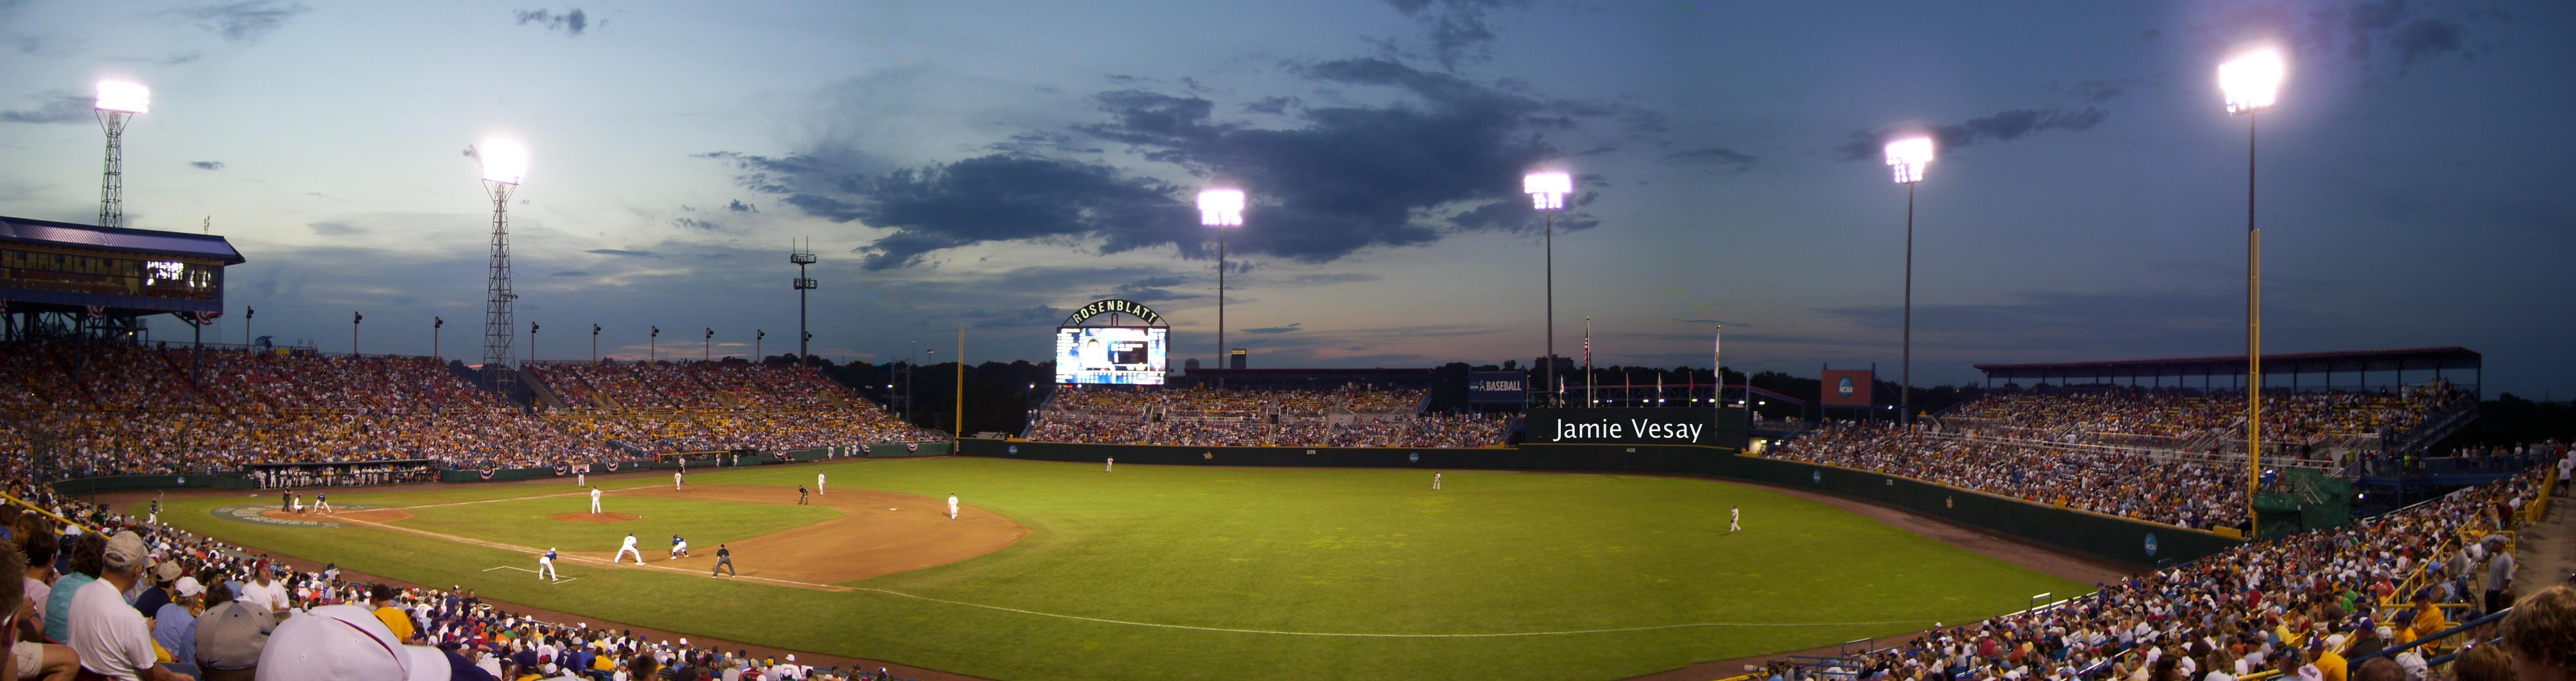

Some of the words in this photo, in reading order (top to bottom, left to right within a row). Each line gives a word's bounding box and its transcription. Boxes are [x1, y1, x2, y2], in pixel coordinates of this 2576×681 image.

[1072, 300, 1158, 324] ROSENBLATT
[1486, 380, 1521, 391] BASEBALL
[563, 655, 568, 665] 7
